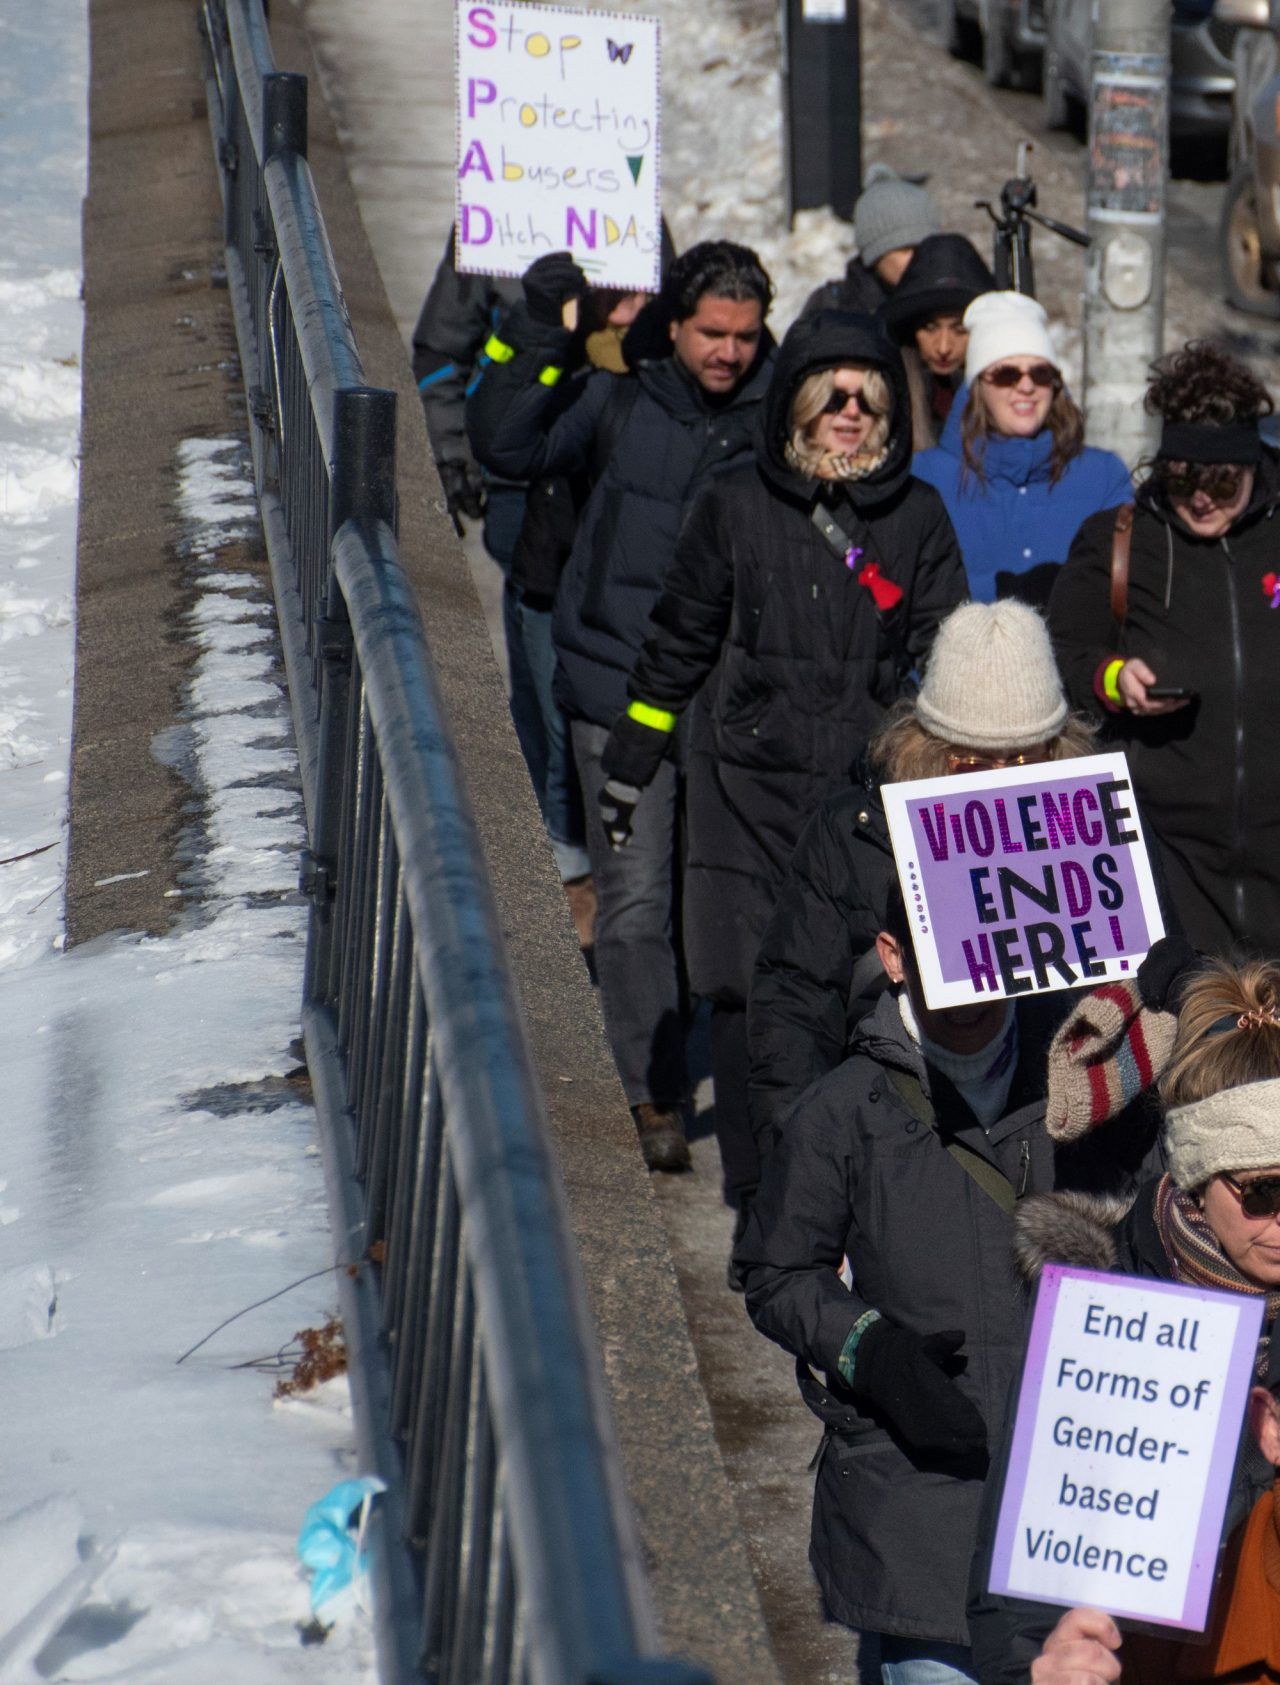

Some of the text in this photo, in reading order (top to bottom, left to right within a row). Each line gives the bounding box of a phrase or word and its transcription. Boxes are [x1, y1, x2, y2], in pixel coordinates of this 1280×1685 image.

[468, 8, 582, 80] Stop
[468, 78, 651, 151] Protecting
[458, 140, 621, 193] Abusers
[461, 204, 553, 247] Ditch
[969, 853, 1124, 924] ENDS
[961, 915, 1129, 996] HERE!
[1083, 1304, 1200, 1352] End all
[1056, 1357, 1211, 1411] Forms of
[1052, 1415, 1190, 1464] Gender-
[1058, 1472, 1160, 1521] based
[1025, 1526, 1168, 1582] Violence
